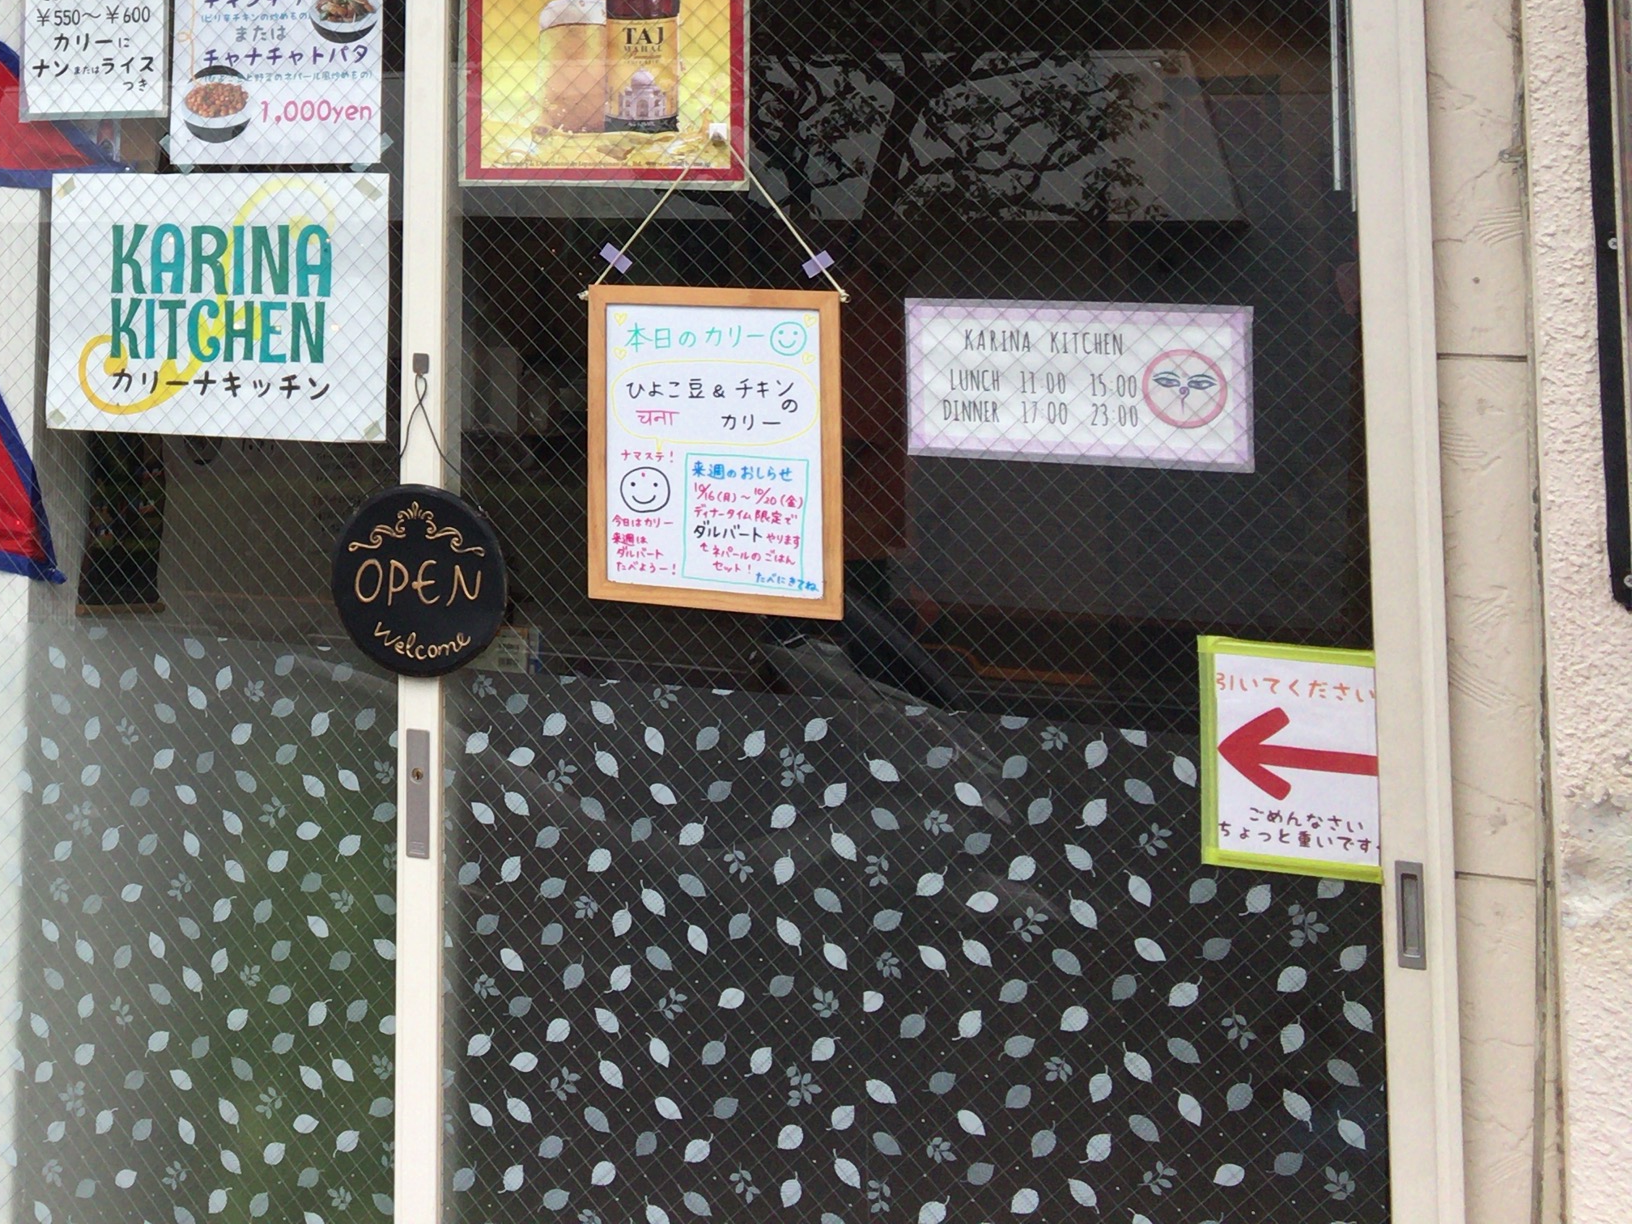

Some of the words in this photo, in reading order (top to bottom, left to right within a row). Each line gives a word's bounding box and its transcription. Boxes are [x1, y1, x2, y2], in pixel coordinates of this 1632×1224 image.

[54, 33, 130, 53] カリーに
[235, 25, 287, 43] または
[622, 26, 664, 45] TAJ
[203, 44, 369, 67] チャナチャトパタ
[123, 78, 147, 92] つき
[261, 100, 372, 124] 1,000yen
[111, 223, 333, 298] KARINA
[110, 298, 325, 364] KITCHEN
[625, 322, 764, 353] 本日のカリー
[964, 329, 1032, 353] KARINA
[1050, 331, 1124, 356] KITCHEN
[112, 368, 330, 400] カリーナキッチン
[949, 368, 1000, 393] LUNCH
[1019, 370, 1067, 396] 11:00
[1090, 373, 1138, 399] 15:00
[635, 409, 680, 426] चना
[721, 413, 781, 431] カリー
[943, 399, 1000, 424] DINNER
[1021, 400, 1069, 426] 17:00
[1090, 404, 1139, 428] 23:00
[692, 460, 793, 482] 来週のおしらせ
[612, 514, 674, 528] 今日はカリー
[612, 532, 648, 546] 来週は
[616, 546, 664, 559] ダルバート
[354, 558, 482, 607] OPEN
[755, 571, 819, 593] たべにきてね
[1249, 806, 1364, 832] ごめんなさい
